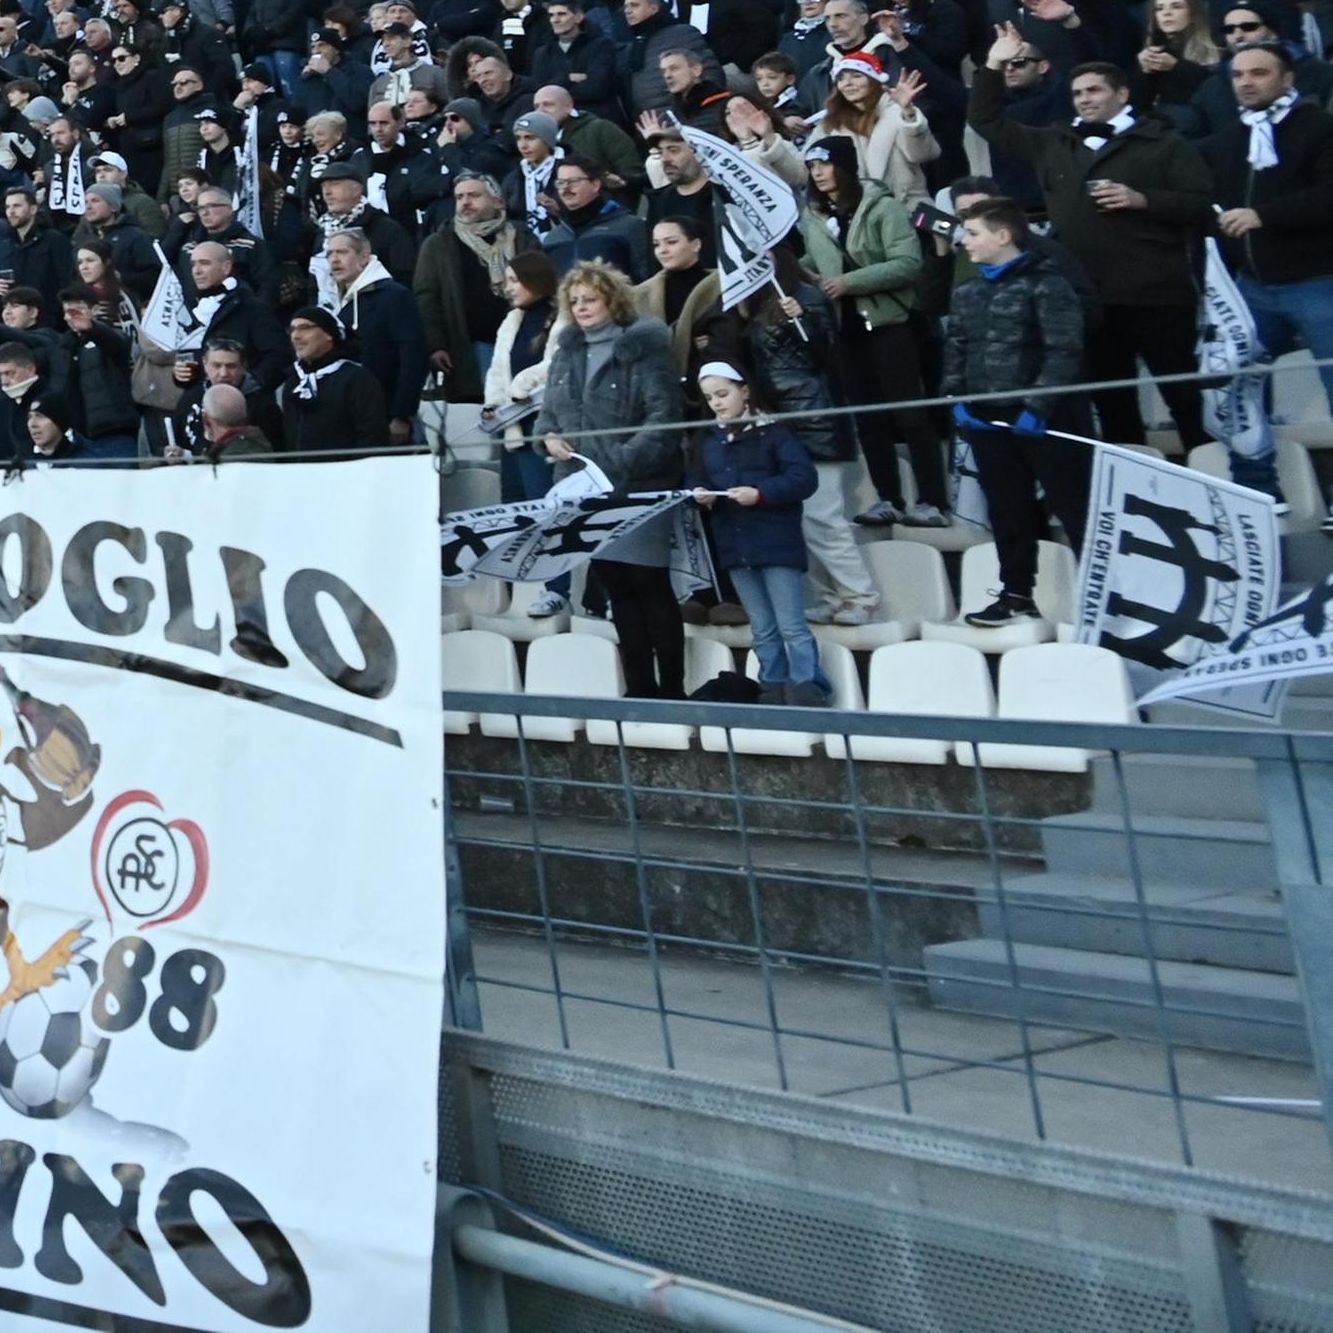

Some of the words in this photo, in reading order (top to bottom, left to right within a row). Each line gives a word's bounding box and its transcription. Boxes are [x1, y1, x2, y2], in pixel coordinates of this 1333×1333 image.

[719, 157, 778, 214] SPERANZA
[1095, 510, 1117, 539] VOI
[1236, 514, 1266, 586] LASCIATE
[1245, 588, 1265, 627] OGNI
[93, 935, 227, 1053] 88
